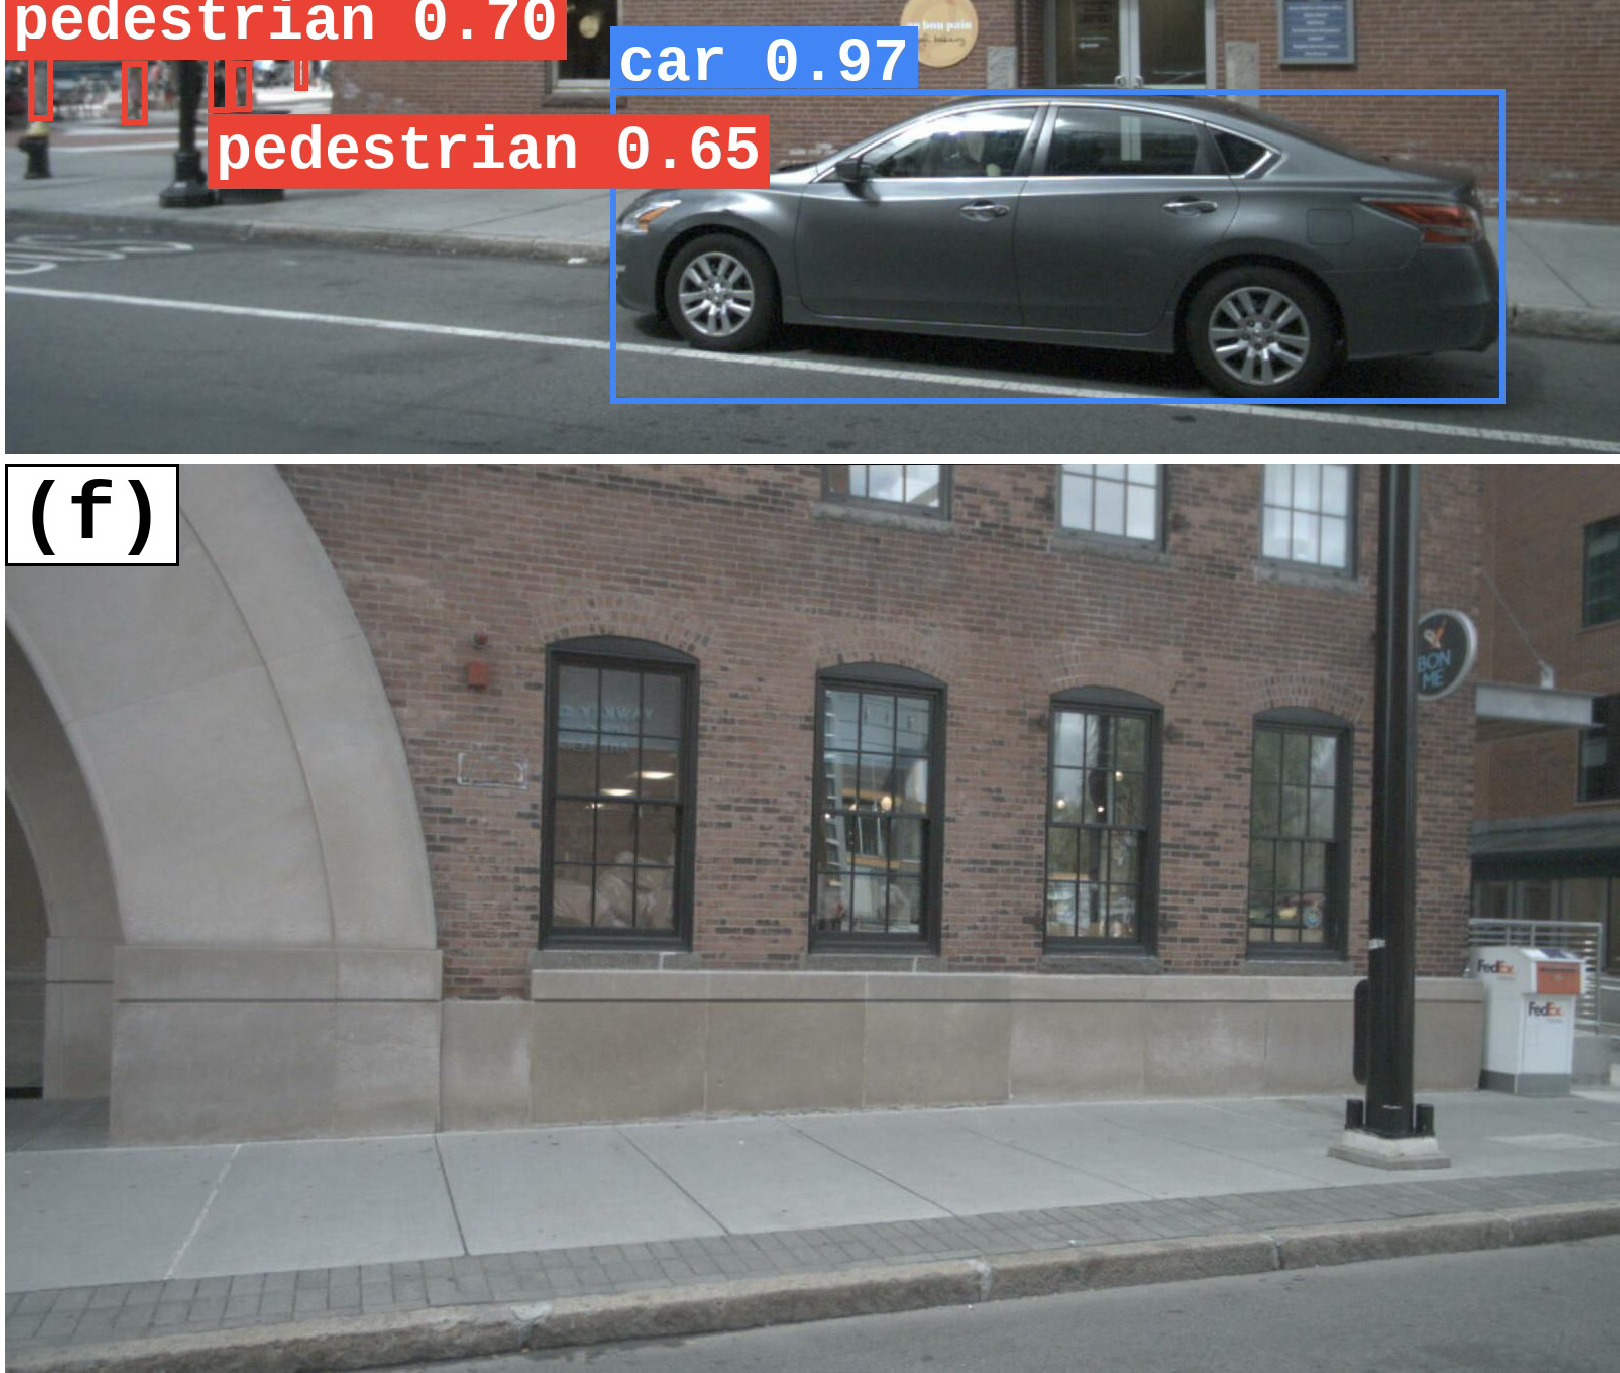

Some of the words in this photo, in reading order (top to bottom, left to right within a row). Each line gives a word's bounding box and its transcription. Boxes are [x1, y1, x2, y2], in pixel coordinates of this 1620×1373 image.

[1417, 649, 1451, 673] BON
[1422, 668, 1445, 691] ME
[1477, 959, 1515, 975] FedEx
[1528, 1001, 1563, 1018] FedEx
